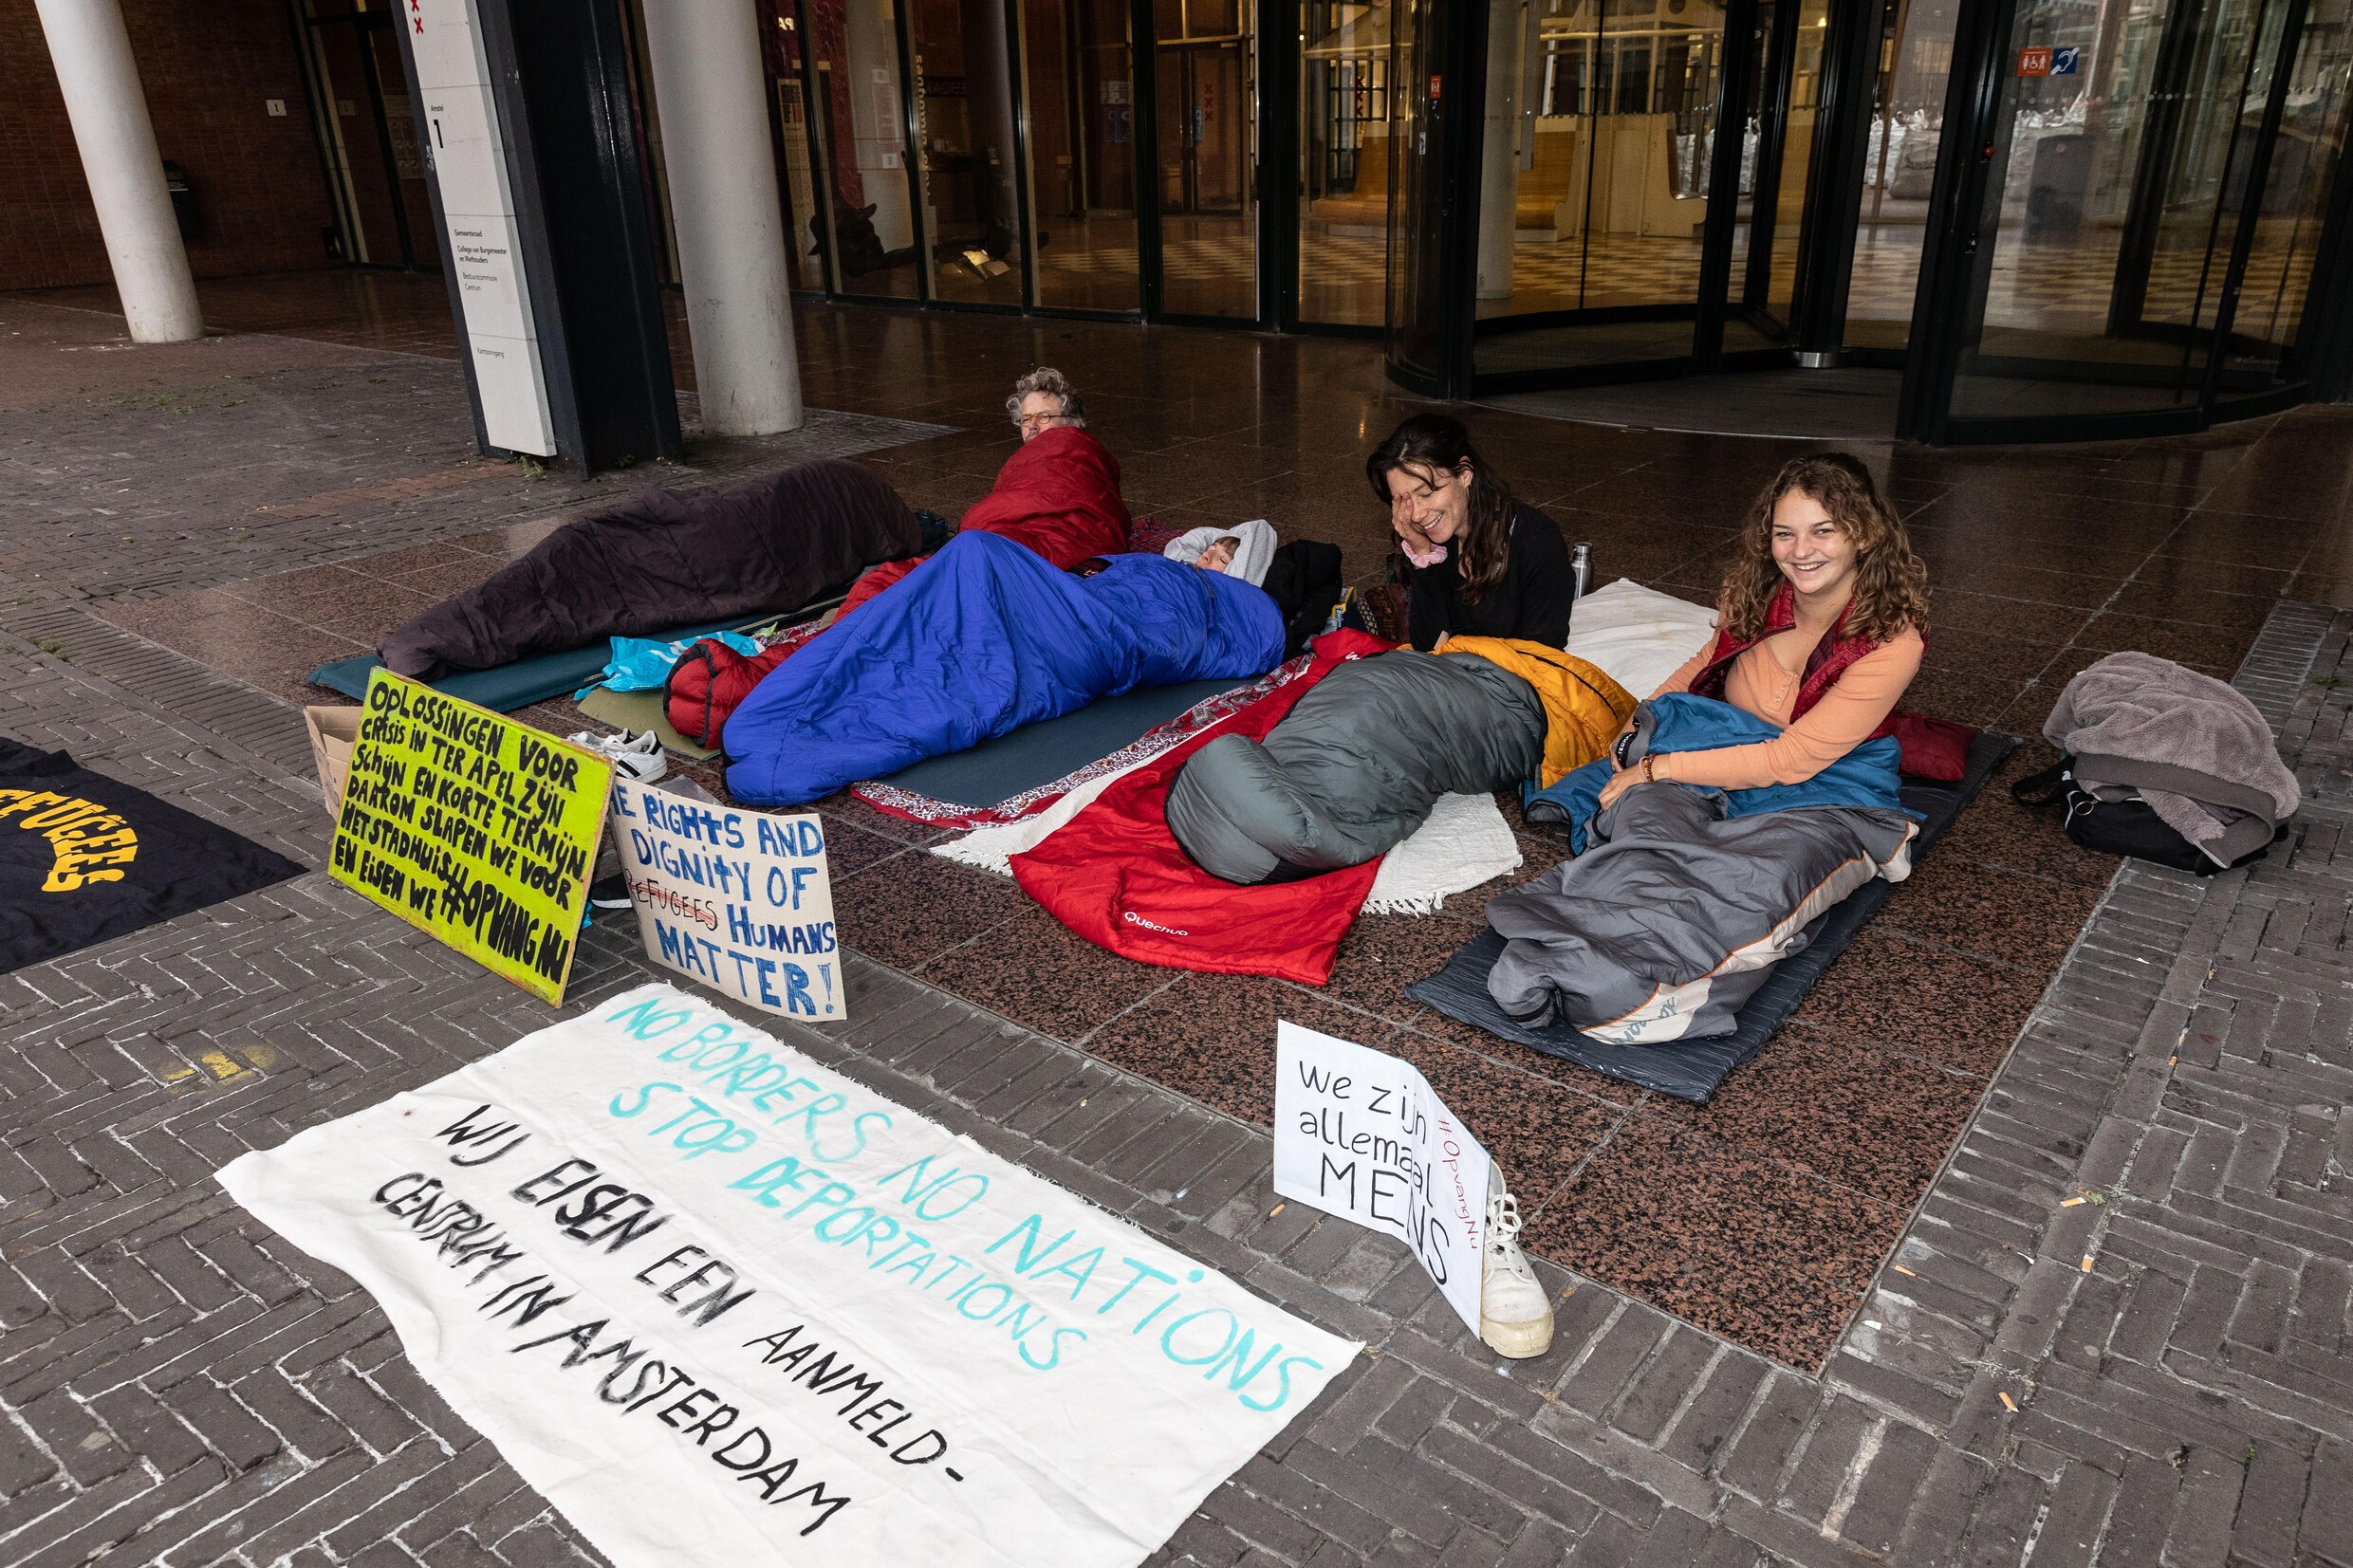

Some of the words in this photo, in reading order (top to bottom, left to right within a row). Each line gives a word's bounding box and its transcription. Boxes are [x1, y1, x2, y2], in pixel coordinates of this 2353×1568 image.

[433, 119, 444, 149] 1
[413, 766, 438, 800] EN
[435, 778, 496, 830] KORTE
[431, 735, 466, 776] TER
[466, 755, 516, 806] APEL
[518, 734, 579, 794] VOOR
[0, 788, 139, 892] EFUGEES
[346, 774, 416, 824] DAAROM
[419, 805, 489, 860] SLAPEN
[490, 839, 518, 878] WE
[519, 855, 572, 911] VOOR
[610, 784, 637, 818] HE
[757, 818, 824, 858] AND
[334, 834, 359, 874] EN
[409, 877, 437, 921] WE
[767, 865, 818, 911] OF
[1123, 911, 1189, 936] Quechua
[655, 917, 835, 1017] MATTER!
[604, 996, 694, 1041] NO
[656, 1022, 894, 1164] BORDERS
[877, 1154, 991, 1222] NO
[1368, 1084, 1427, 1145] zijn
[1299, 1107, 1434, 1209] allemaal
[370, 1171, 528, 1288] CENTRUM
[609, 1081, 759, 1161] STOP
[726, 1155, 1088, 1371] DEPORTATIONS
[1320, 1152, 1450, 1286] MENS
[432, 1103, 532, 1169] WIJ
[509, 1154, 676, 1255] EISEN
[633, 1243, 757, 1329] EEN
[741, 1324, 964, 1482] AANMELD-
[476, 1273, 580, 1330] IN
[506, 1318, 852, 1537] AMSTERDAM
